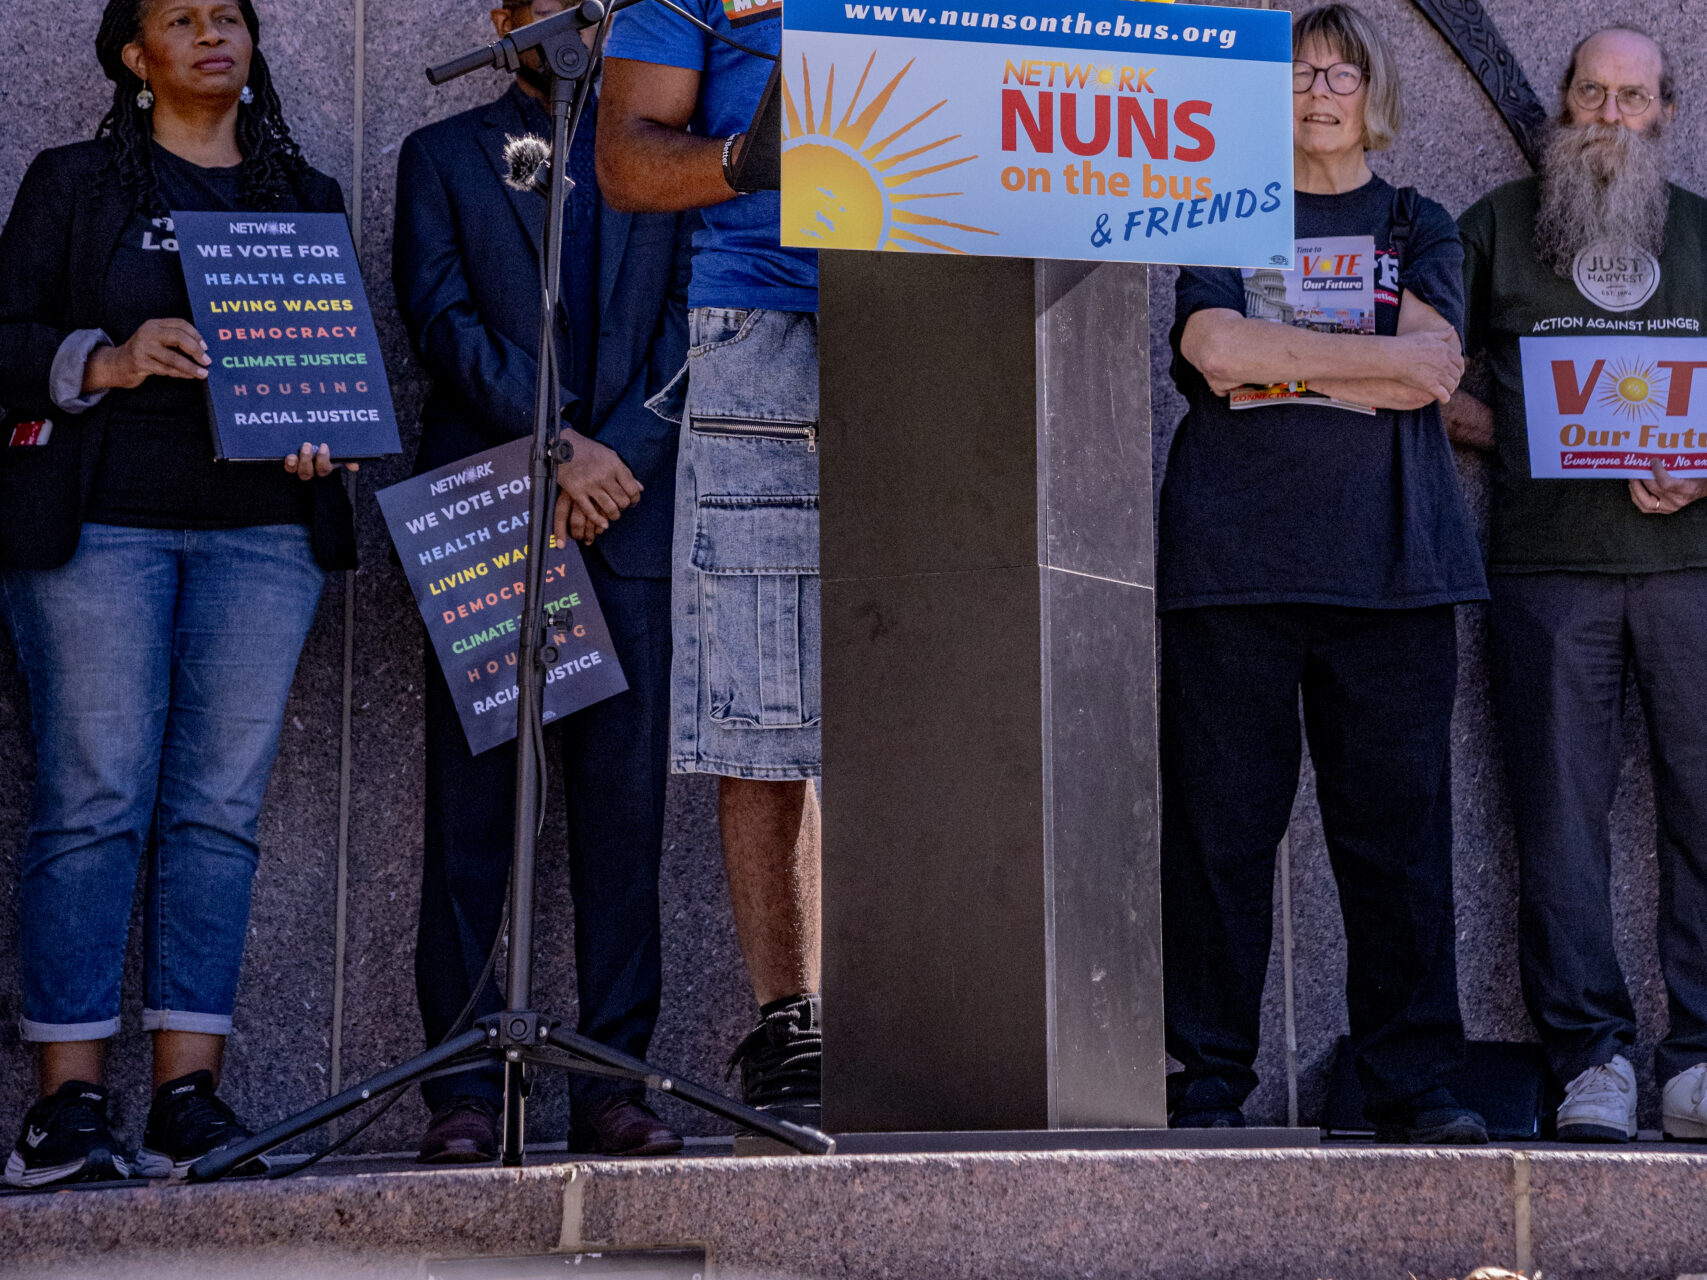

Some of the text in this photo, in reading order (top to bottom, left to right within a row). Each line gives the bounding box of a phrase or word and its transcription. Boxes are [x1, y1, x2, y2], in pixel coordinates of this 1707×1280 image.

[844, 2, 1237, 49] www.nunsonthebus.org
[1001, 88, 1216, 163] NUNS
[1000, 160, 1214, 202] on the bus
[1090, 181, 1282, 248] & FRIENDS
[196, 244, 340, 258] WE VOTE FOR
[1587, 256, 1641, 272] JUST
[204, 272, 347, 286] HEALTH CARE
[1303, 279, 1362, 289] Our Future
[1587, 273, 1644, 283] HARVEST
[210, 299, 354, 313] LIVING WAGES
[218, 326, 358, 341] DEMOCRACY
[1532, 316, 1700, 333] ACTION AGAINST HUNGER
[222, 353, 368, 368] CLIMATE JUSTICE
[233, 380, 369, 396] HOUSING
[234, 409, 380, 425] RACIAL JUSTICE
[1559, 423, 1631, 447] Our
[1563, 453, 1621, 469] Everyone
[1623, 453, 1671, 467] thris.
[1673, 455, 1691, 468] No
[405, 511, 439, 535] WE
[440, 490, 495, 520] VOTE
[418, 510, 530, 566] HEALTH CA
[429, 534, 557, 596] LIVING WAS
[442, 563, 566, 625] DEMOCRCY
[452, 618, 517, 654] CLIMATE
[467, 624, 586, 683] HOUNG
[473, 651, 603, 715] RACIA USTICE
